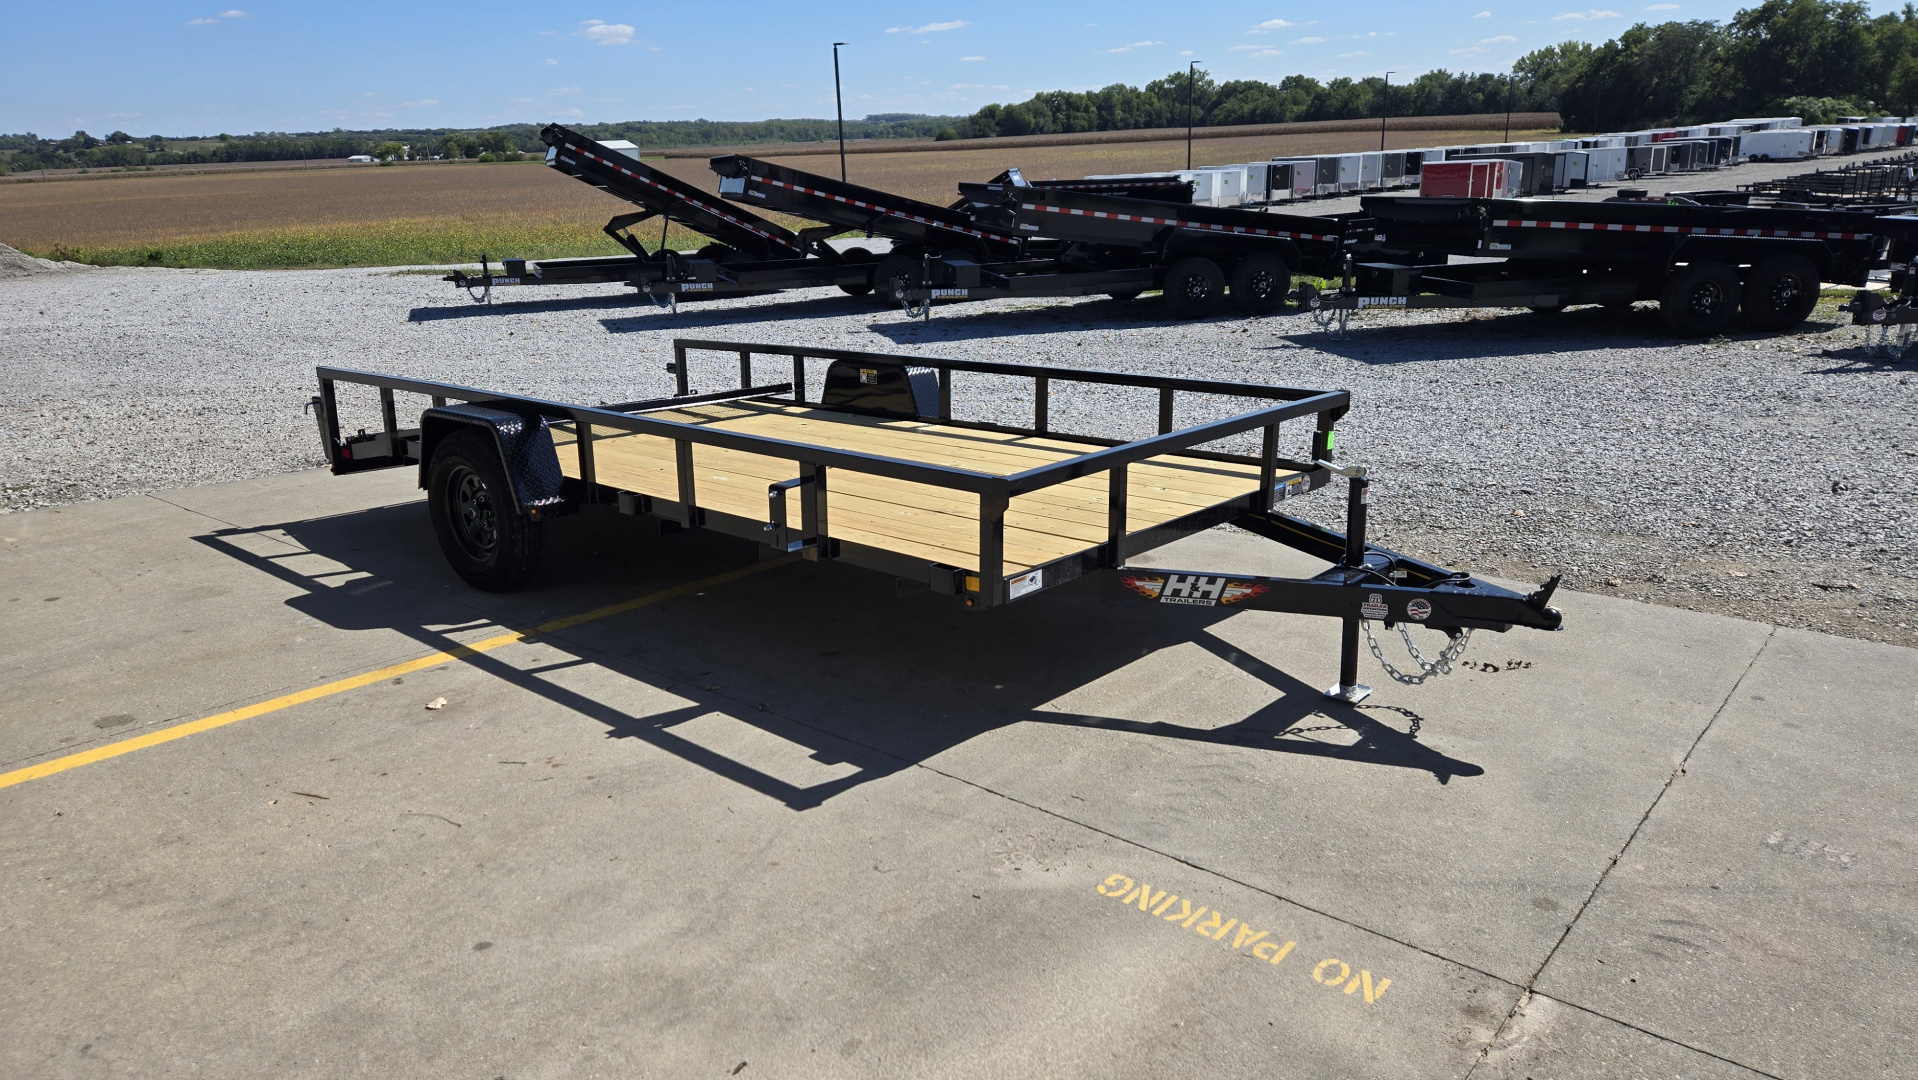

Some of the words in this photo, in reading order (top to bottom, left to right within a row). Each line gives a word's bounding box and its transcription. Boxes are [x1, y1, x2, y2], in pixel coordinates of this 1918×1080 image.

[681, 283, 713, 292] PUNCH
[931, 289, 968, 299] PUNCH
[1358, 297, 1406, 308] PUNCH
[1162, 574, 1227, 600] H&H
[1163, 597, 1213, 606] TRAILERS
[1096, 873, 1296, 965] PARKING
[1312, 957, 1392, 1004] NO
